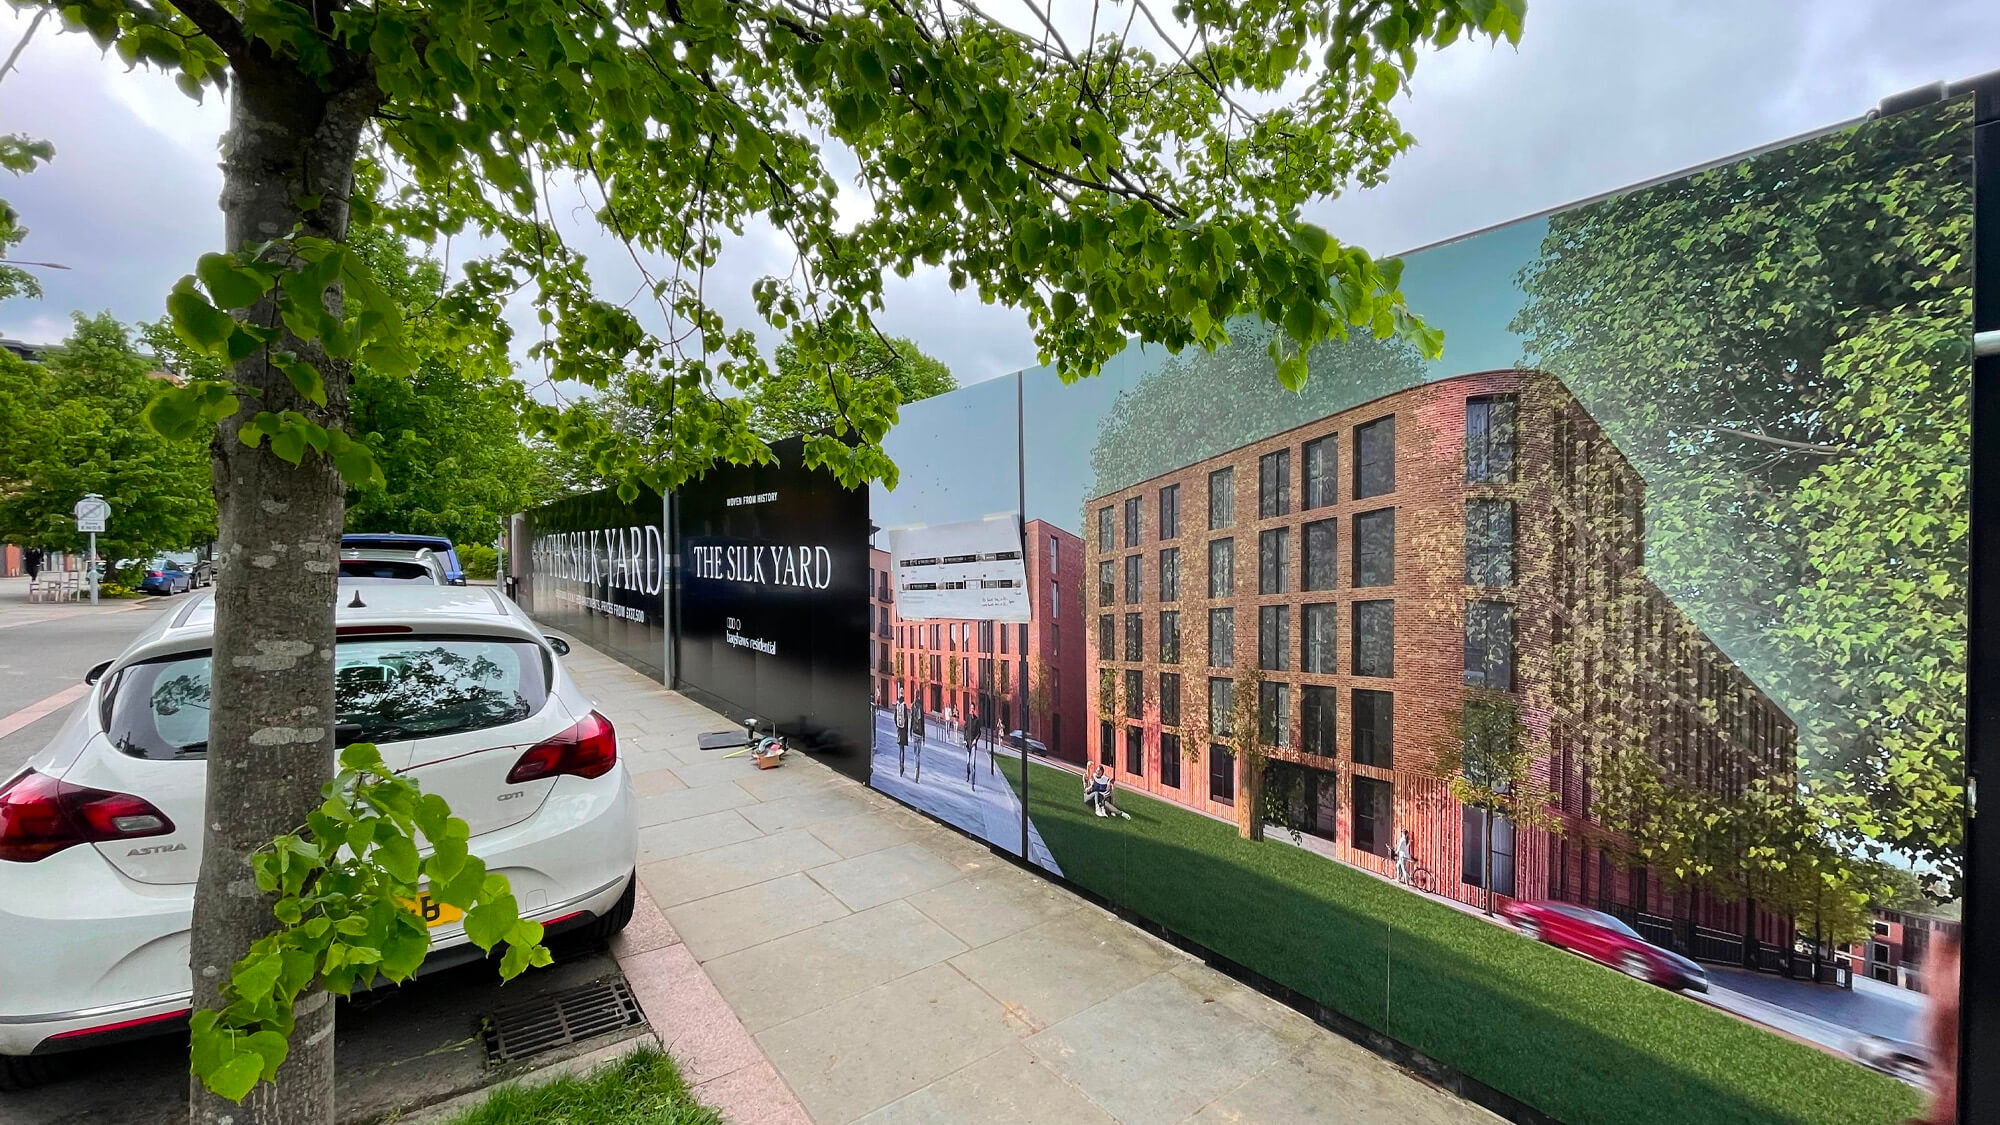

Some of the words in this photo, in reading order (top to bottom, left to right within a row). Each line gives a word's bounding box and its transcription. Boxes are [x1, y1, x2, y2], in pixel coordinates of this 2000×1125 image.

[743, 495, 757, 505] FROM
[757, 491, 778, 503] HISTORY
[547, 532, 569, 579] THE
[570, 529, 602, 588] SILK
[605, 525, 662, 595] YARD
[693, 545, 723, 580] THE
[727, 545, 766, 585] SILK
[770, 545, 831, 589] YARD
[749, 637, 777, 656] residential
[127, 842, 188, 857] ASTRA
